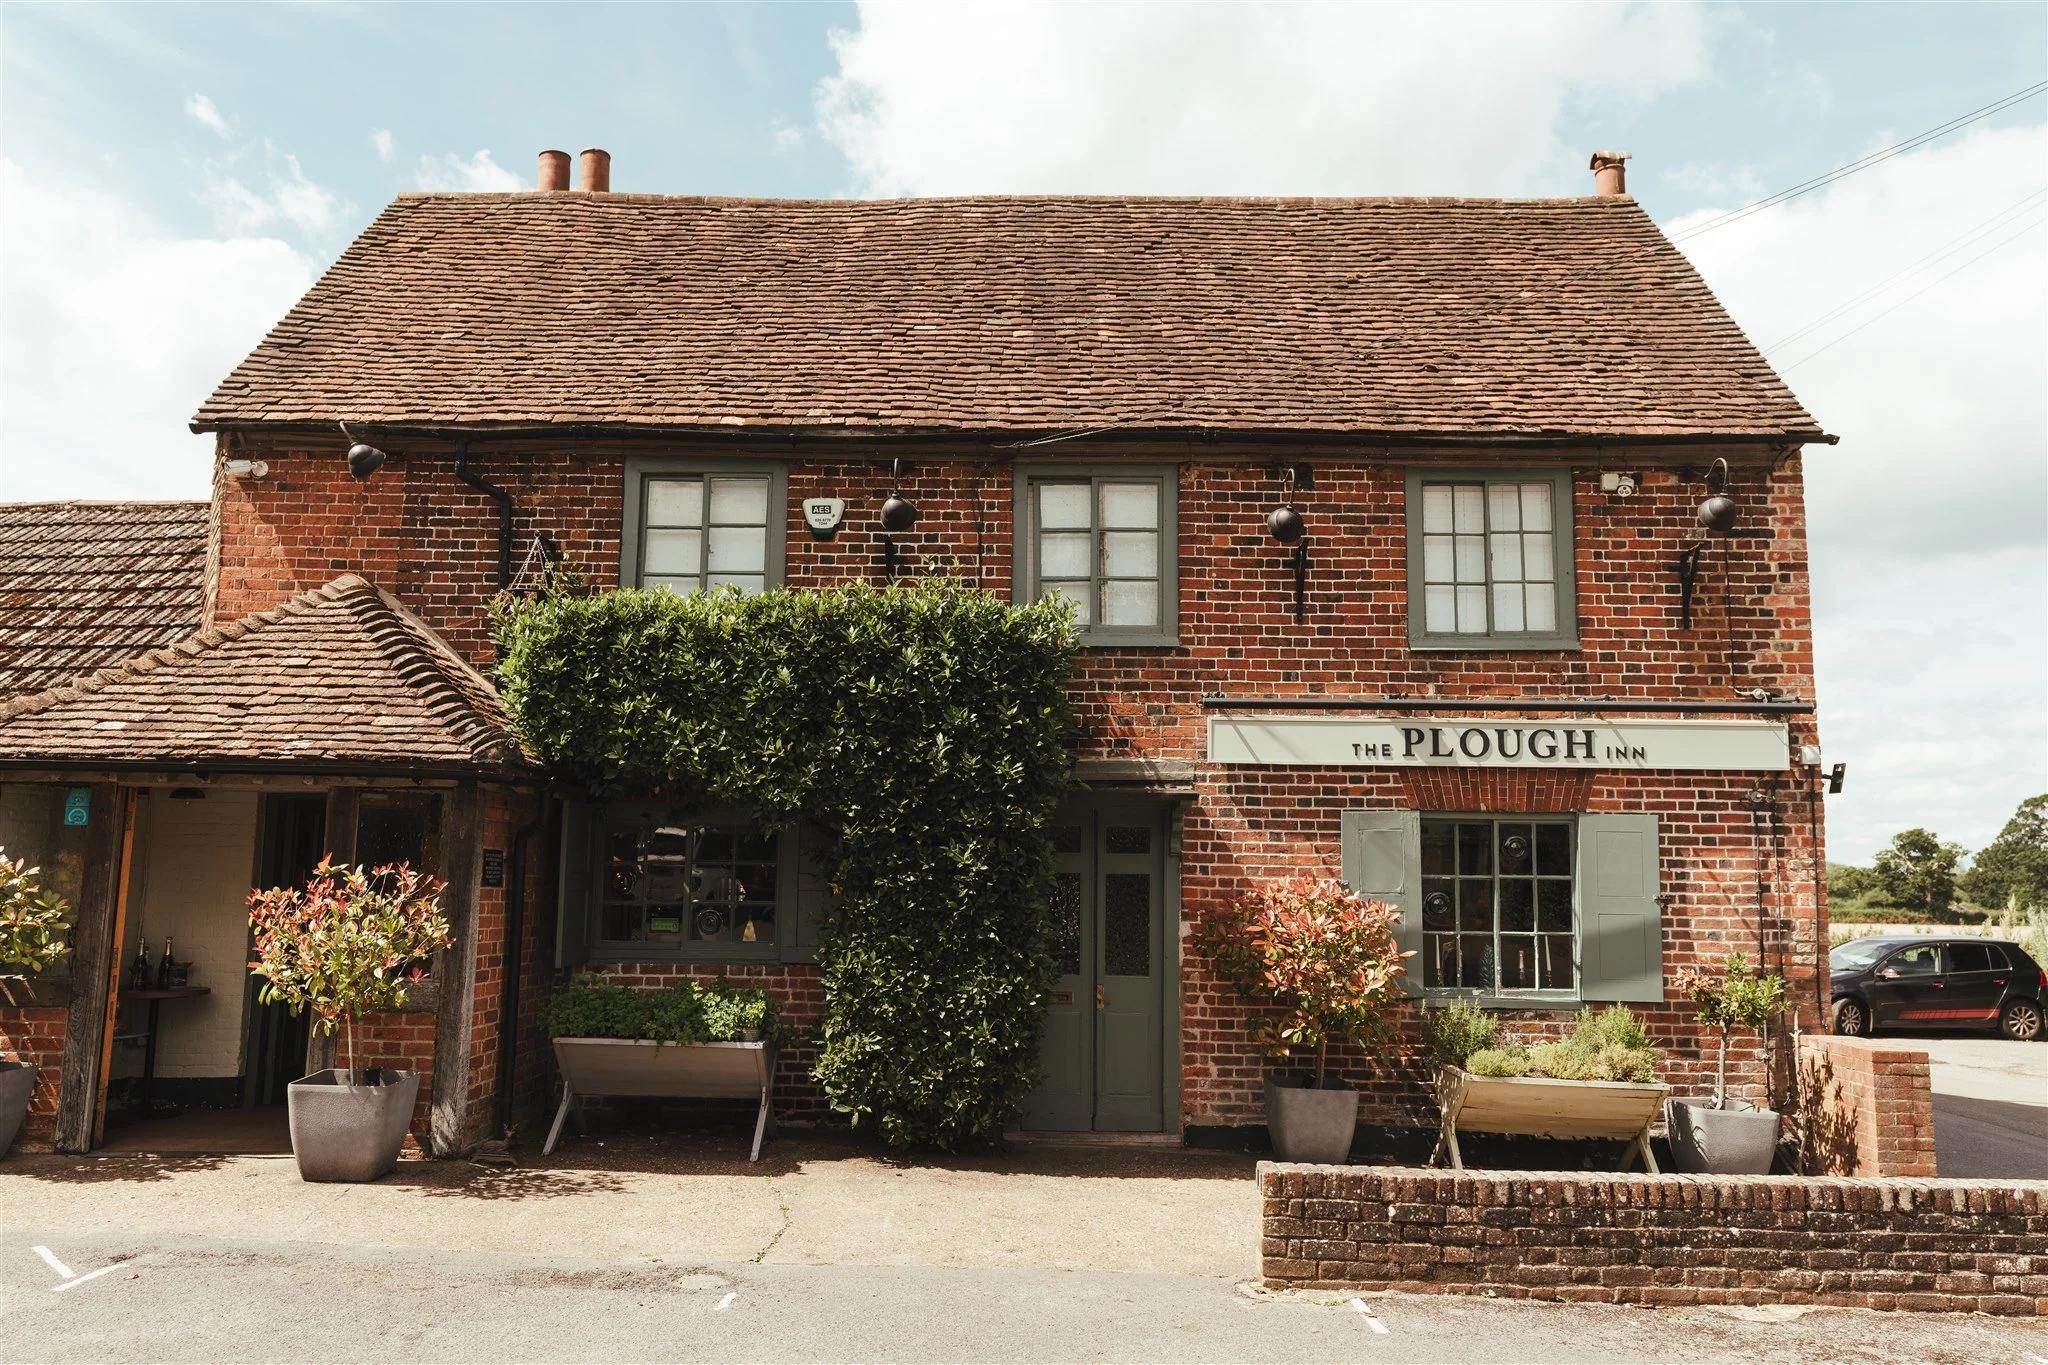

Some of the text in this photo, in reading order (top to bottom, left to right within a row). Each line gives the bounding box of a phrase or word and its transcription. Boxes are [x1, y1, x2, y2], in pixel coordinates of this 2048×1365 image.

[813, 506, 830, 514] AES
[1352, 727, 1645, 760] THE PLOUGH INN
